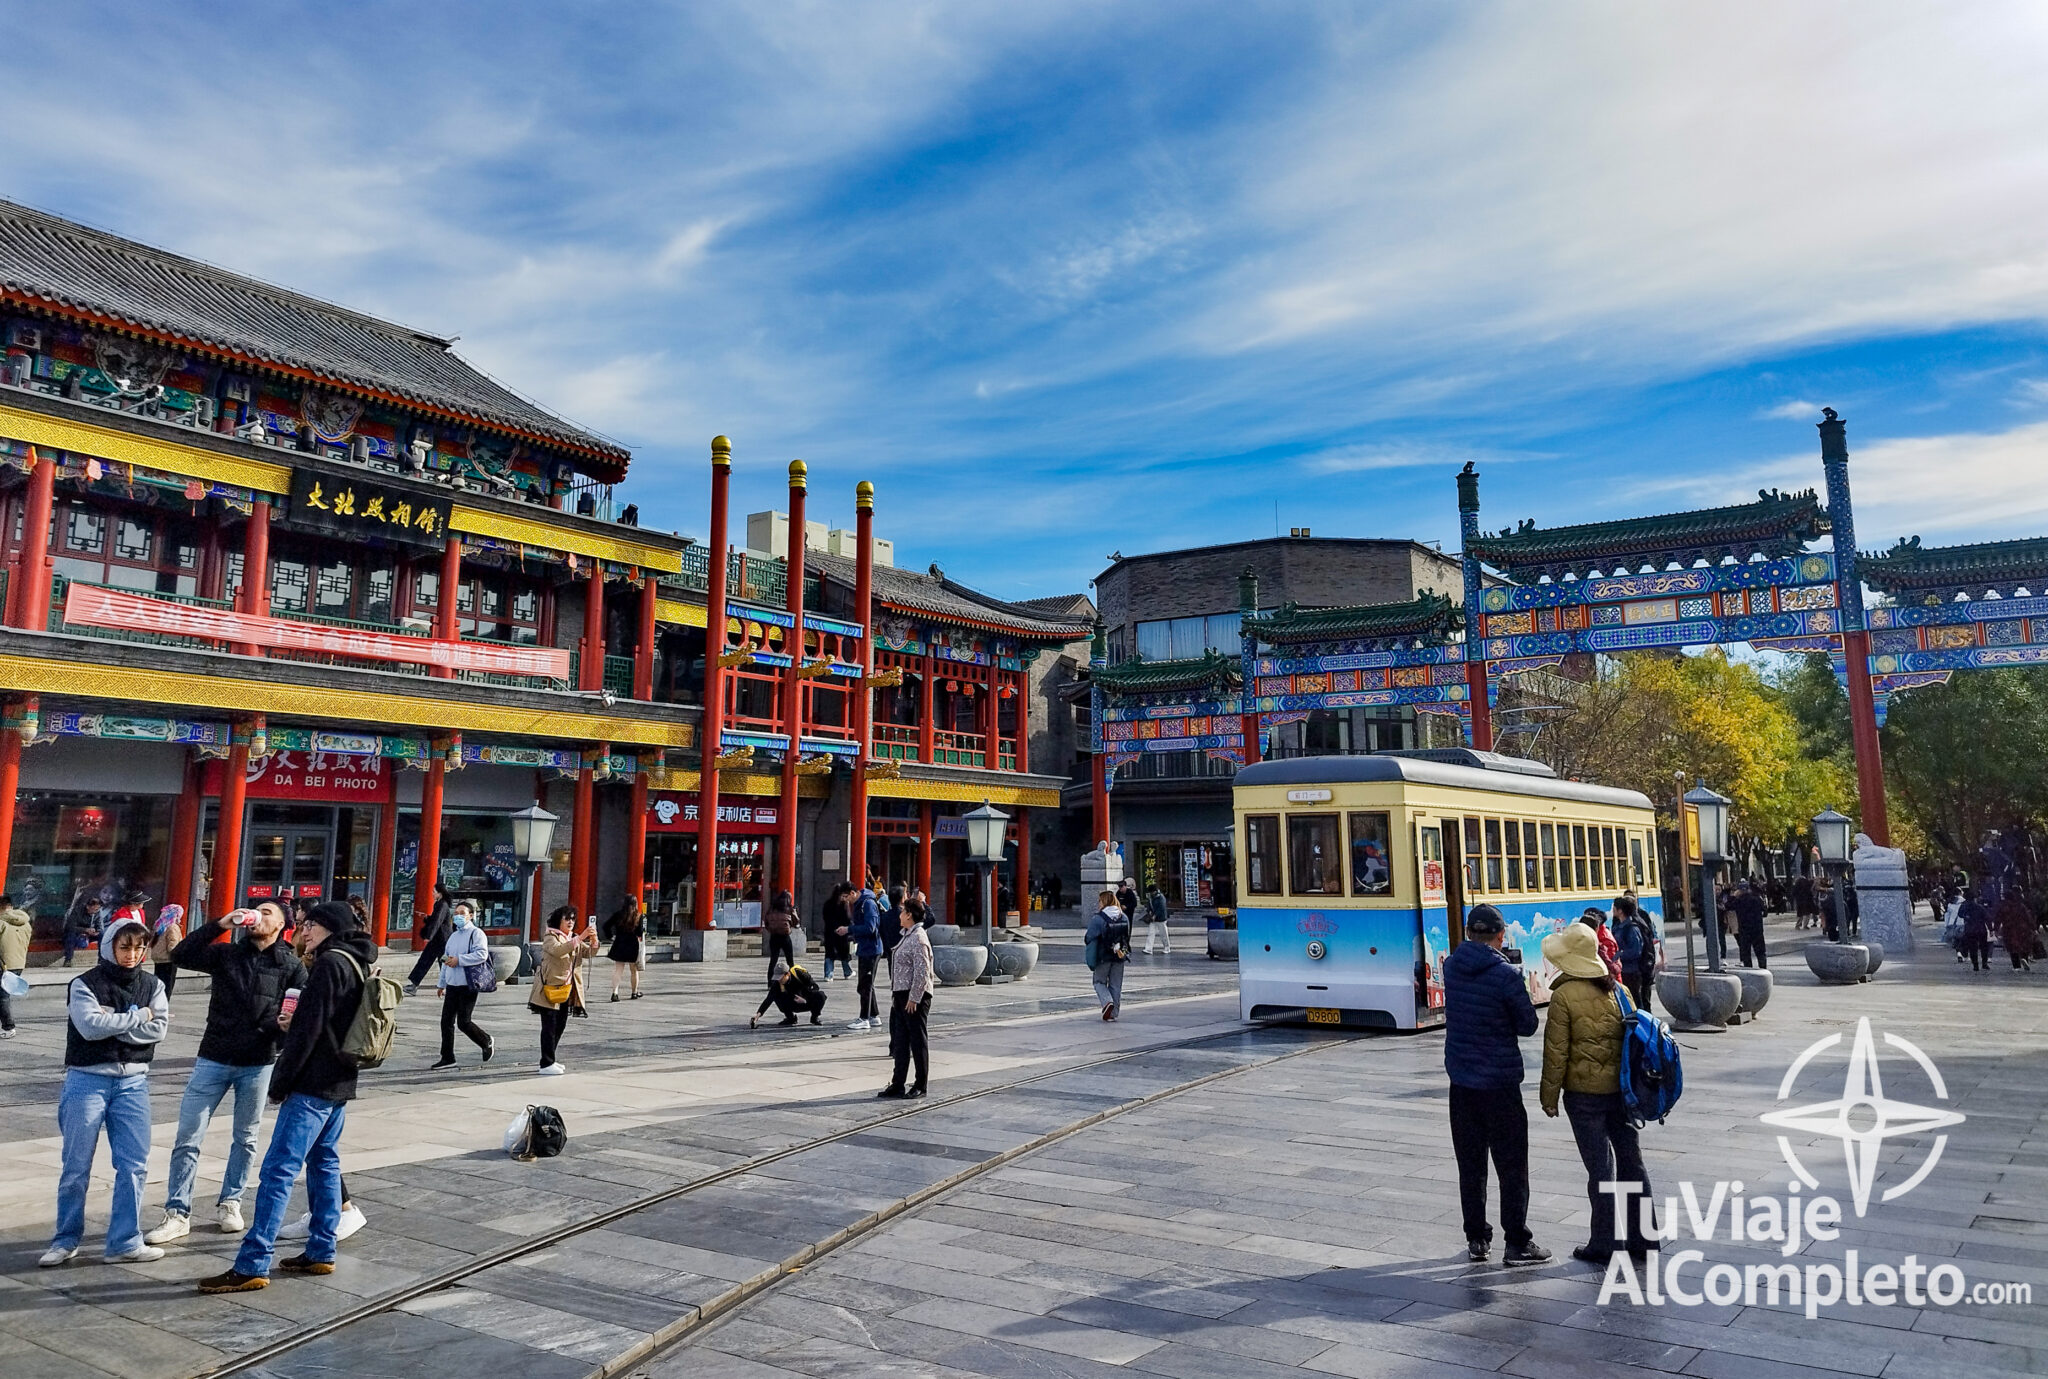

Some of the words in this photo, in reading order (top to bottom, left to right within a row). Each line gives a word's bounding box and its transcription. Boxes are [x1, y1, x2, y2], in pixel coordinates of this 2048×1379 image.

[275, 774, 293, 786] DA
[305, 776, 325, 787] BEI
[334, 777, 377, 790] PHOTO
[684, 805, 752, 822] 京便利店
